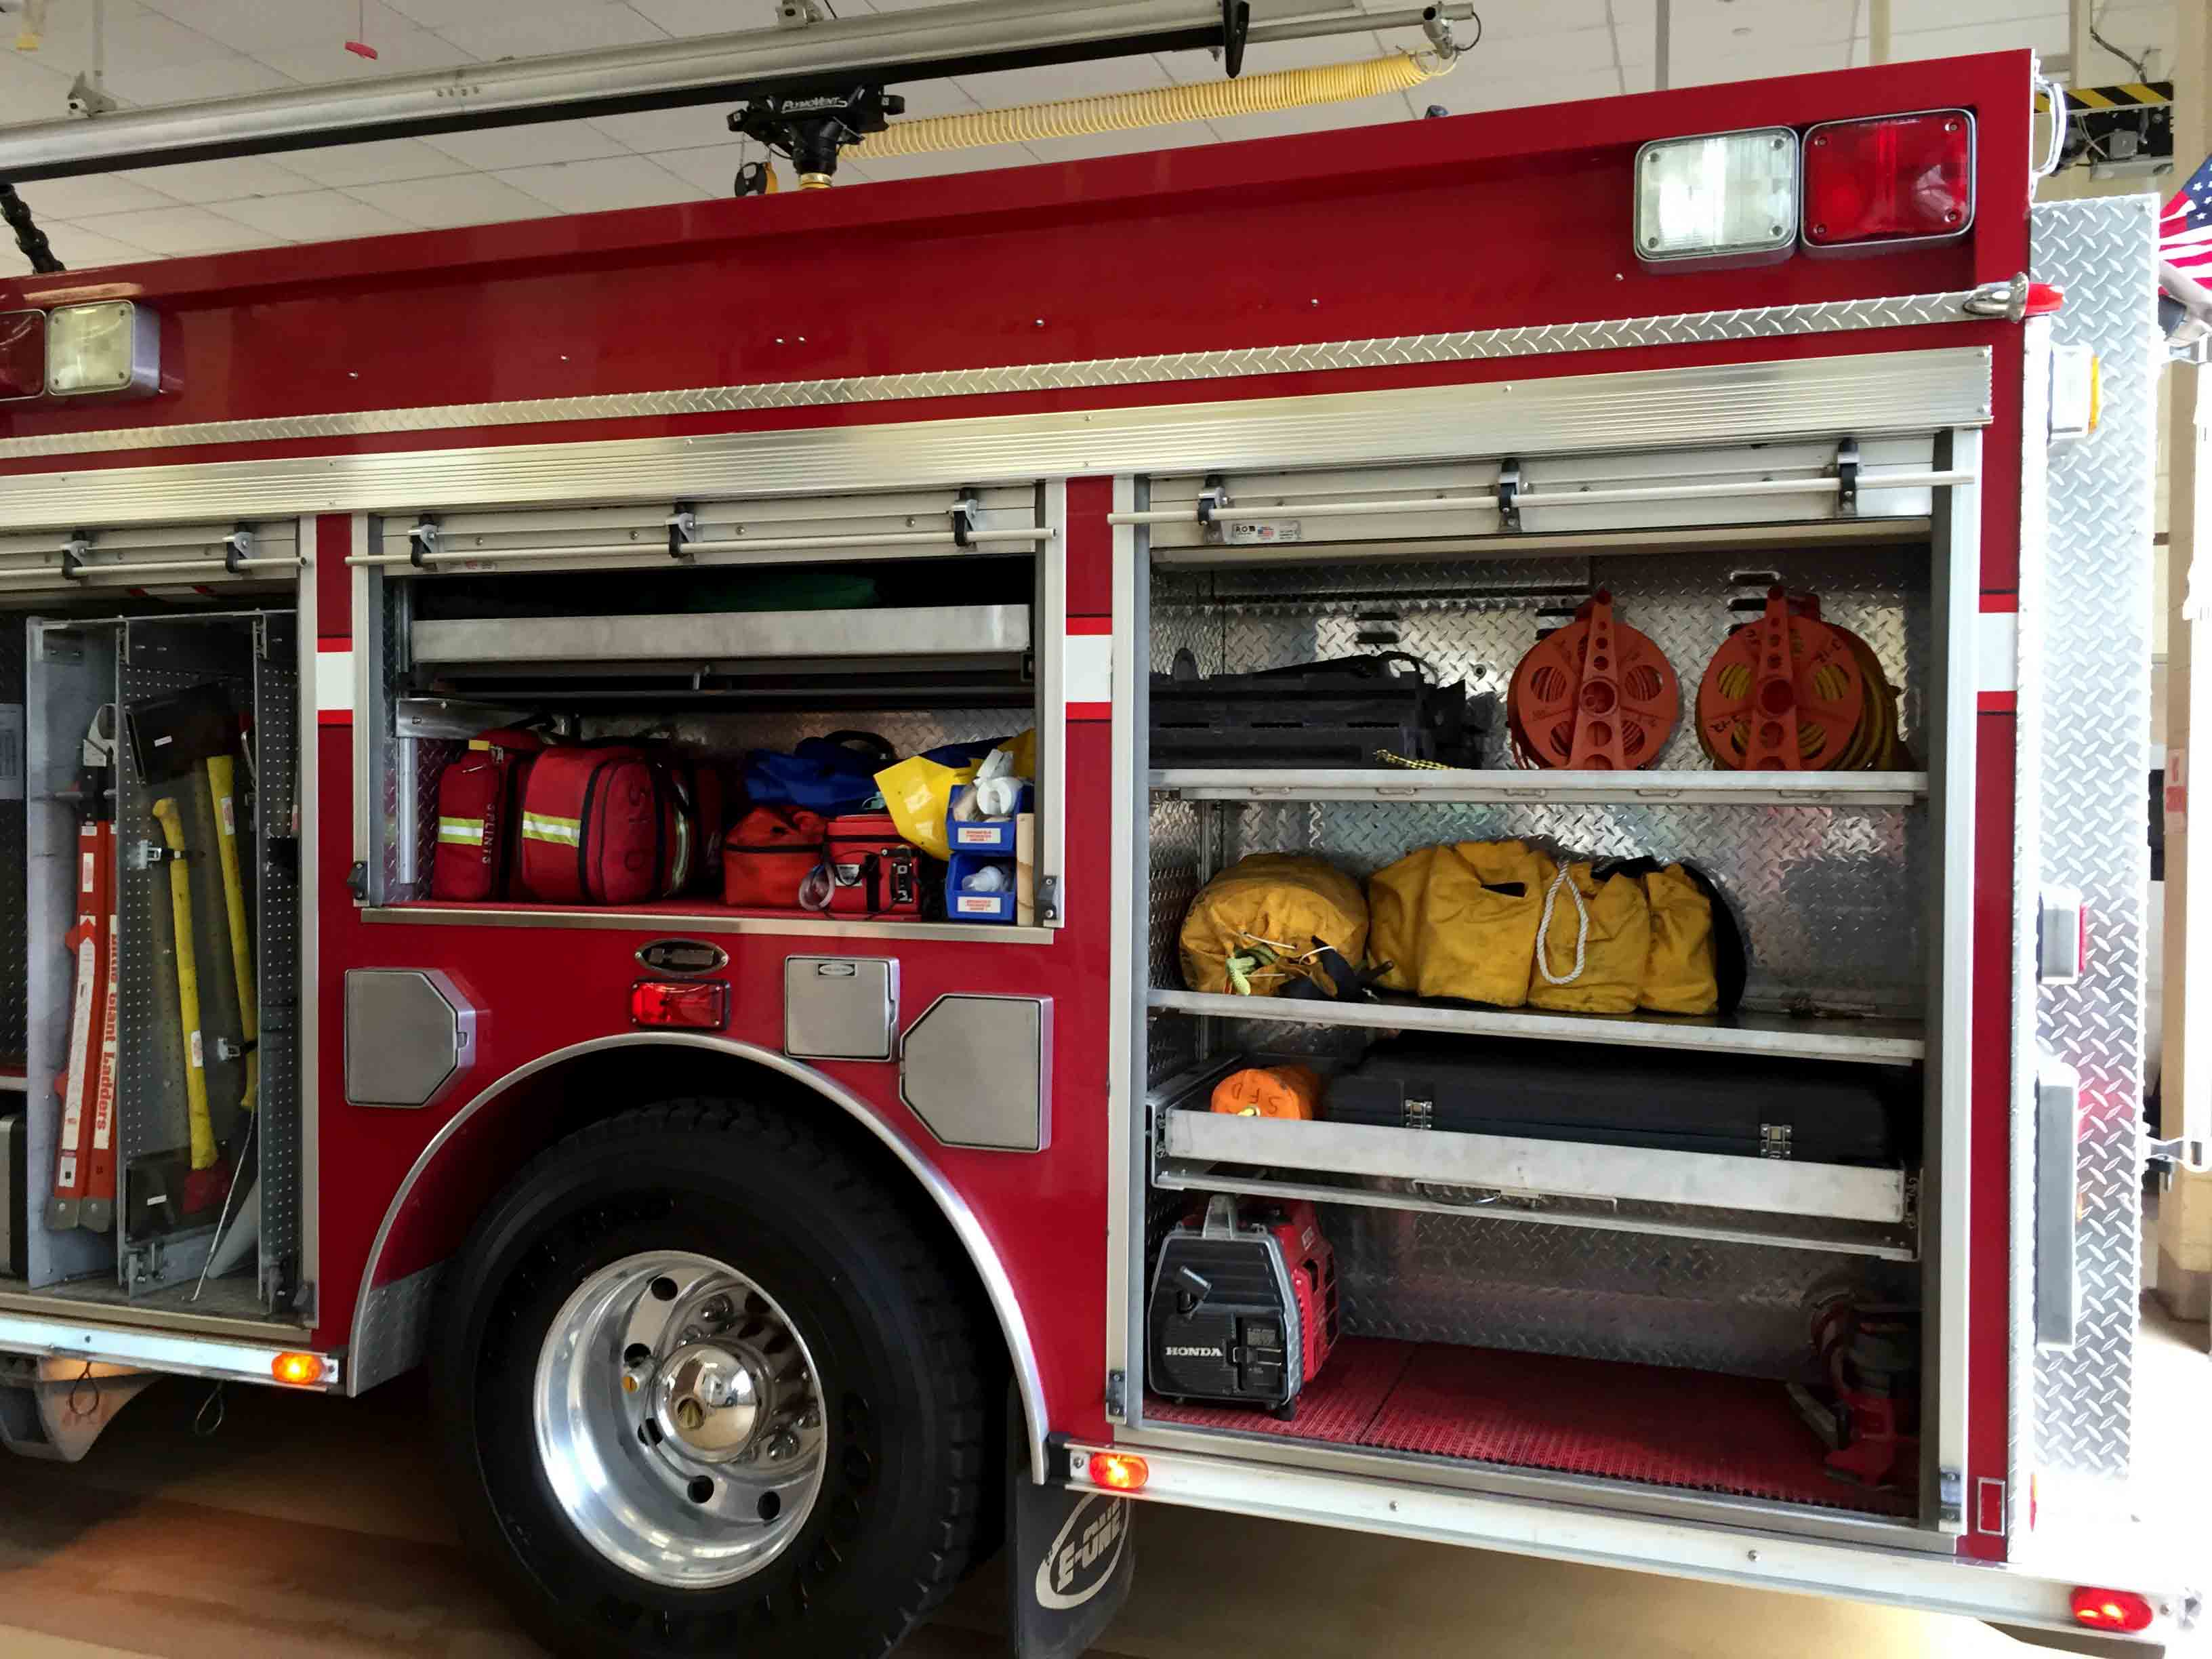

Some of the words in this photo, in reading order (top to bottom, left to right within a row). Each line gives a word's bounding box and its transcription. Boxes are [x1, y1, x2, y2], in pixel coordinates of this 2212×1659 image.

[482, 802, 495, 867] SPLINTS
[96, 1052, 115, 1130] Ladders
[1165, 1347, 1224, 1357] HONDA
[1057, 1496, 1122, 1593] E-ONE
